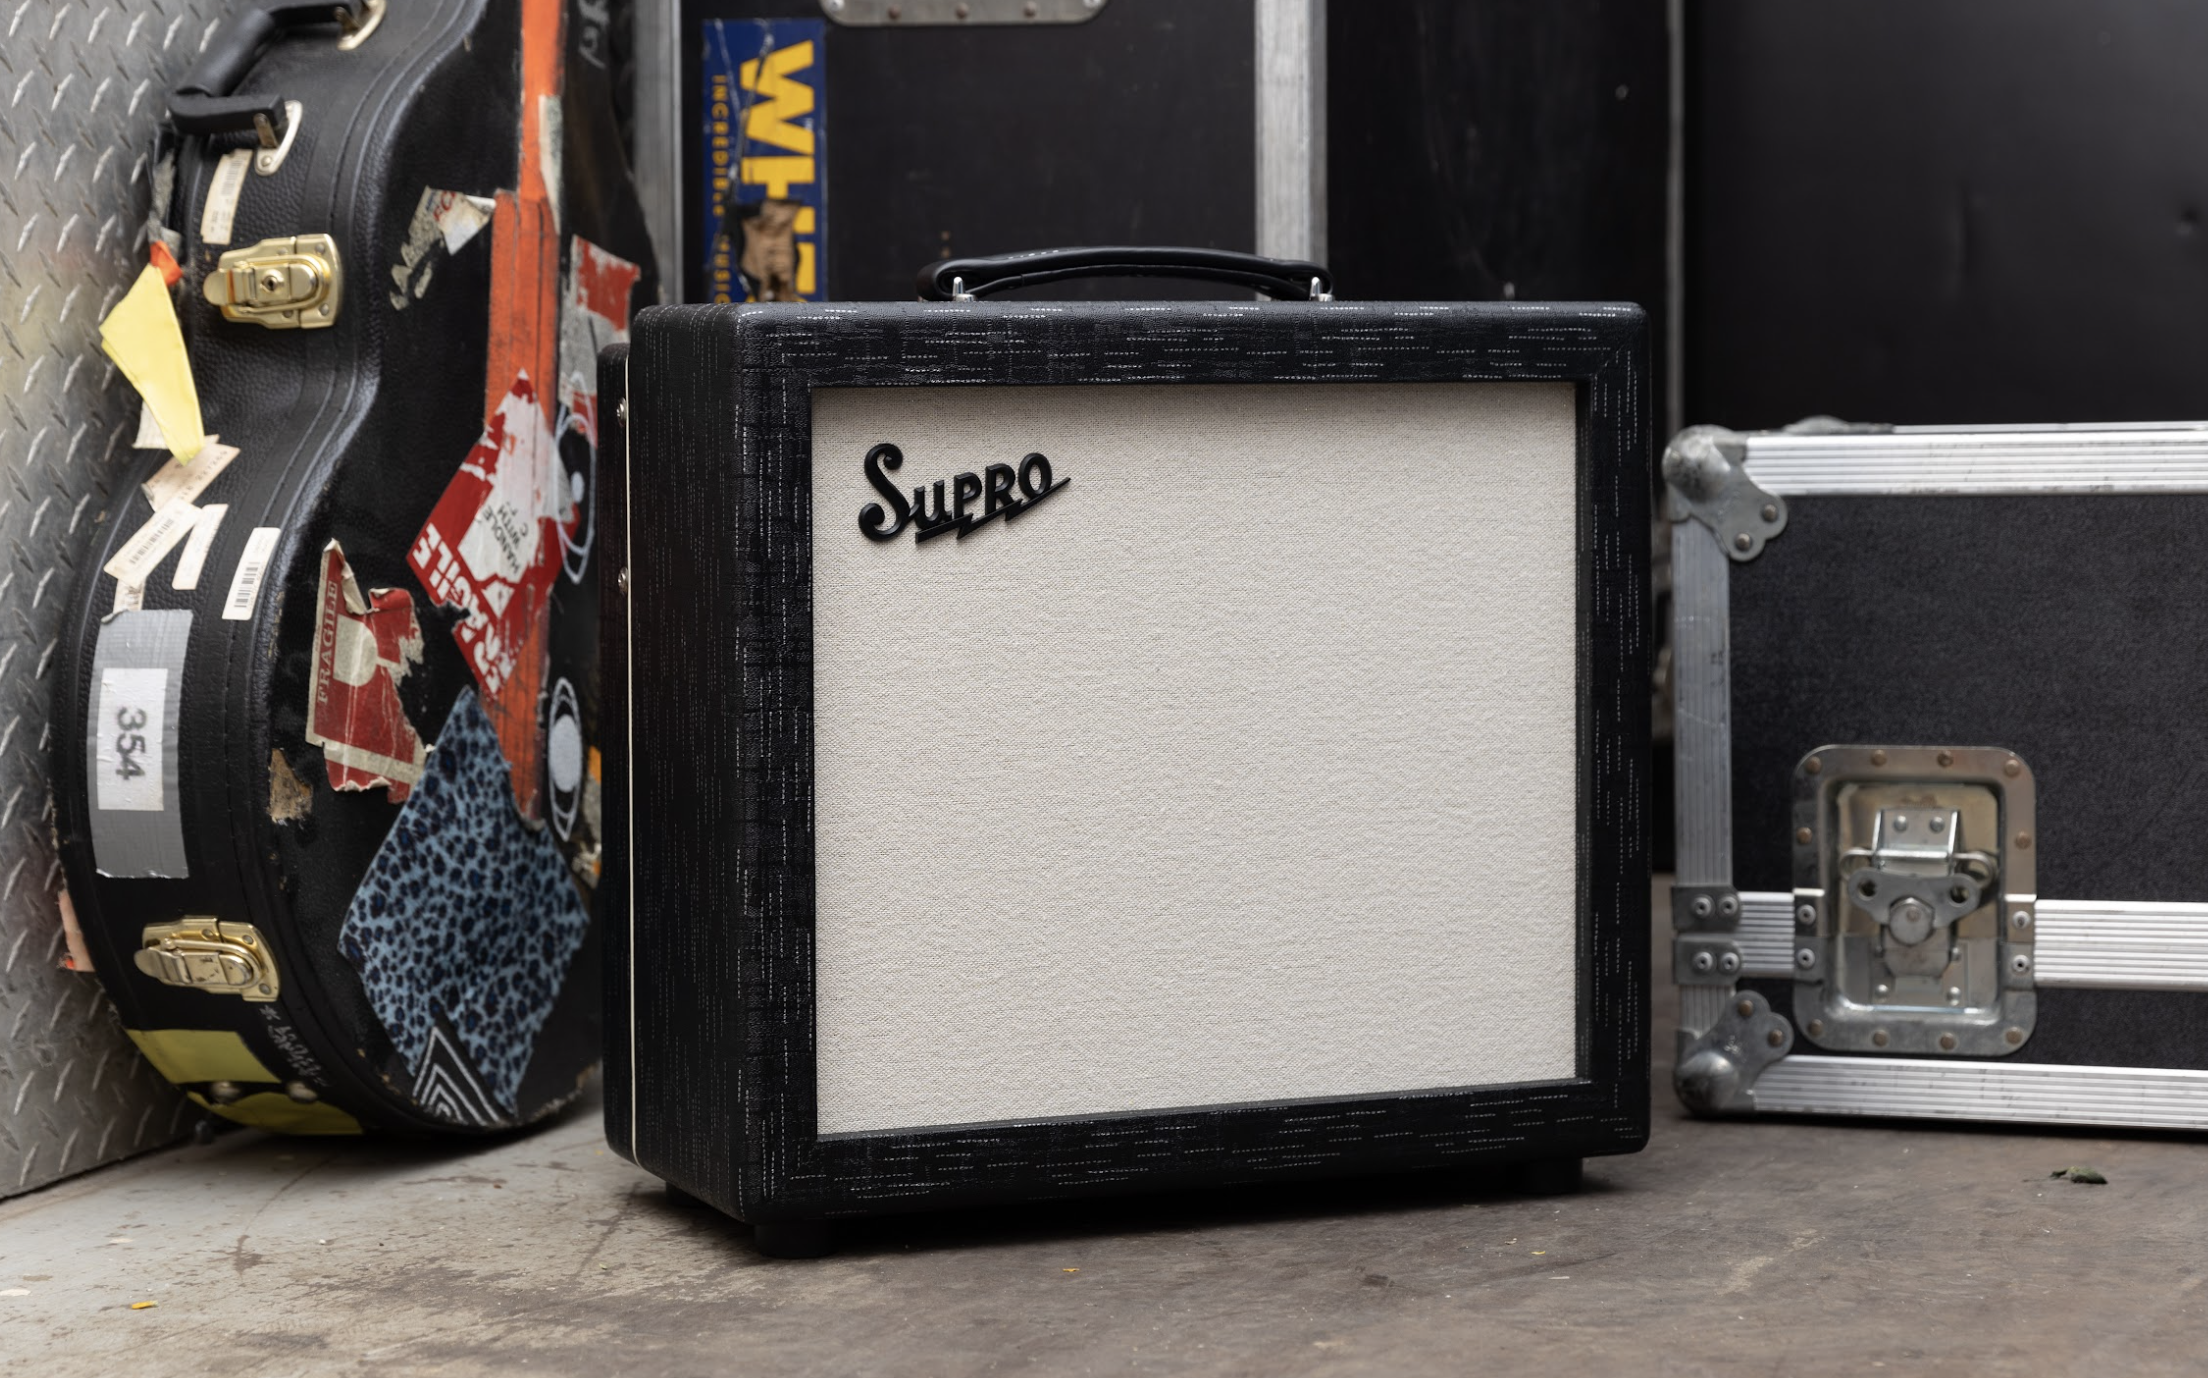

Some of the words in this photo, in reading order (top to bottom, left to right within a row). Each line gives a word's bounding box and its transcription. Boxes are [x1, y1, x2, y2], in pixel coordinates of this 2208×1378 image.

[740, 39, 816, 303] WH
[483, 504, 521, 573] HANDLE
[497, 504, 522, 547] WITH
[317, 581, 339, 705] FRAGILE
[115, 706, 148, 781] 354
